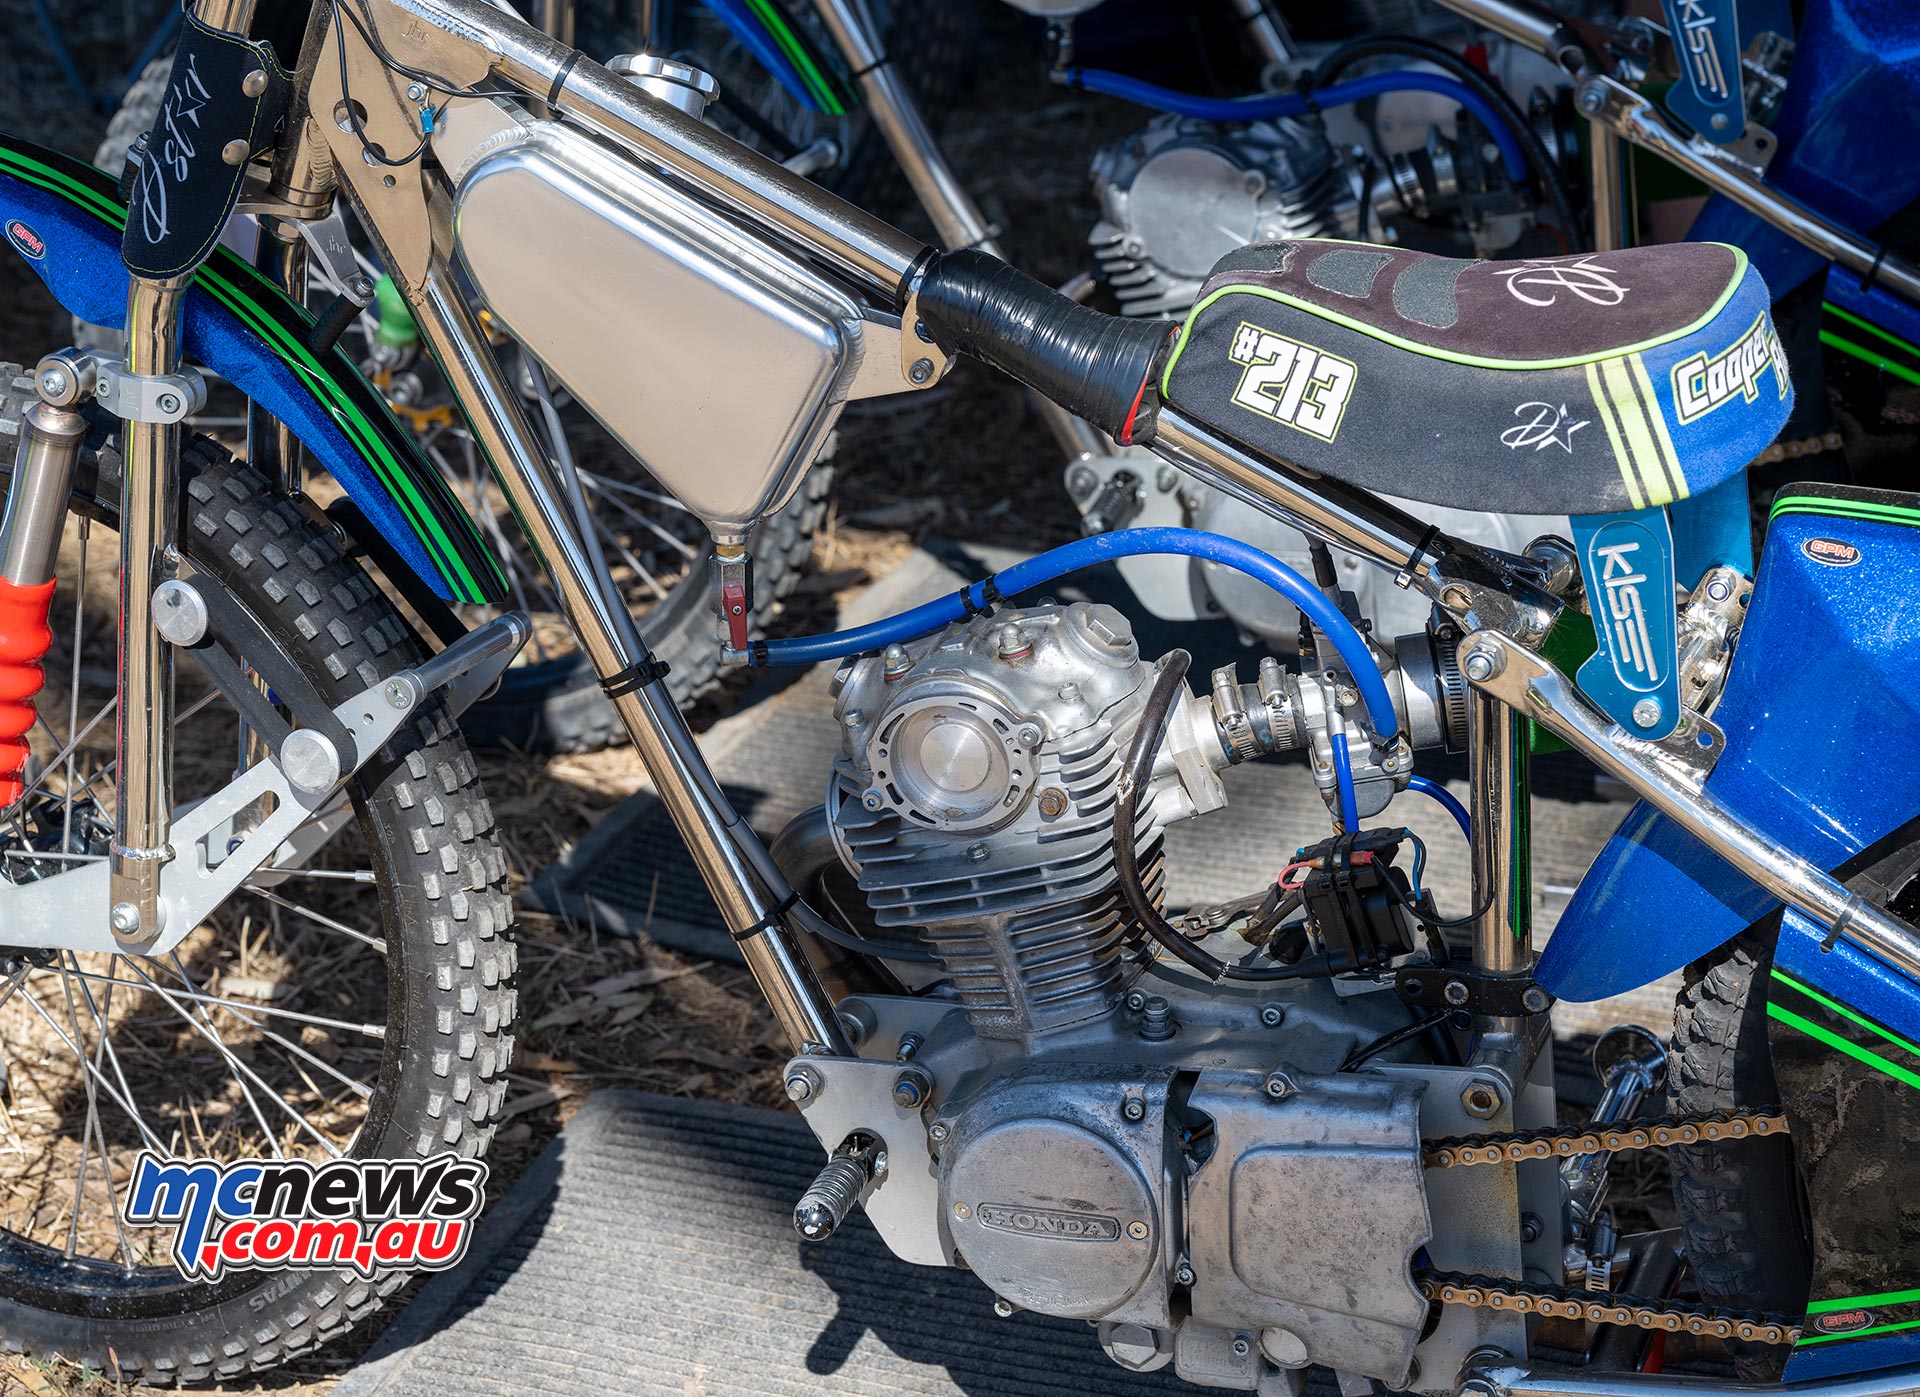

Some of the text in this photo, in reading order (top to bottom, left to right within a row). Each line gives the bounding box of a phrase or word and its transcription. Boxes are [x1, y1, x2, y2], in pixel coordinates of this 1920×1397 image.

[12, 223, 44, 253] GPM
[1229, 321, 1358, 443] #213
[1671, 310, 1771, 425] Cooper
[1810, 540, 1856, 559] GPM
[984, 1208, 1110, 1237] HONDA
[1822, 1311, 1866, 1327] GPM
